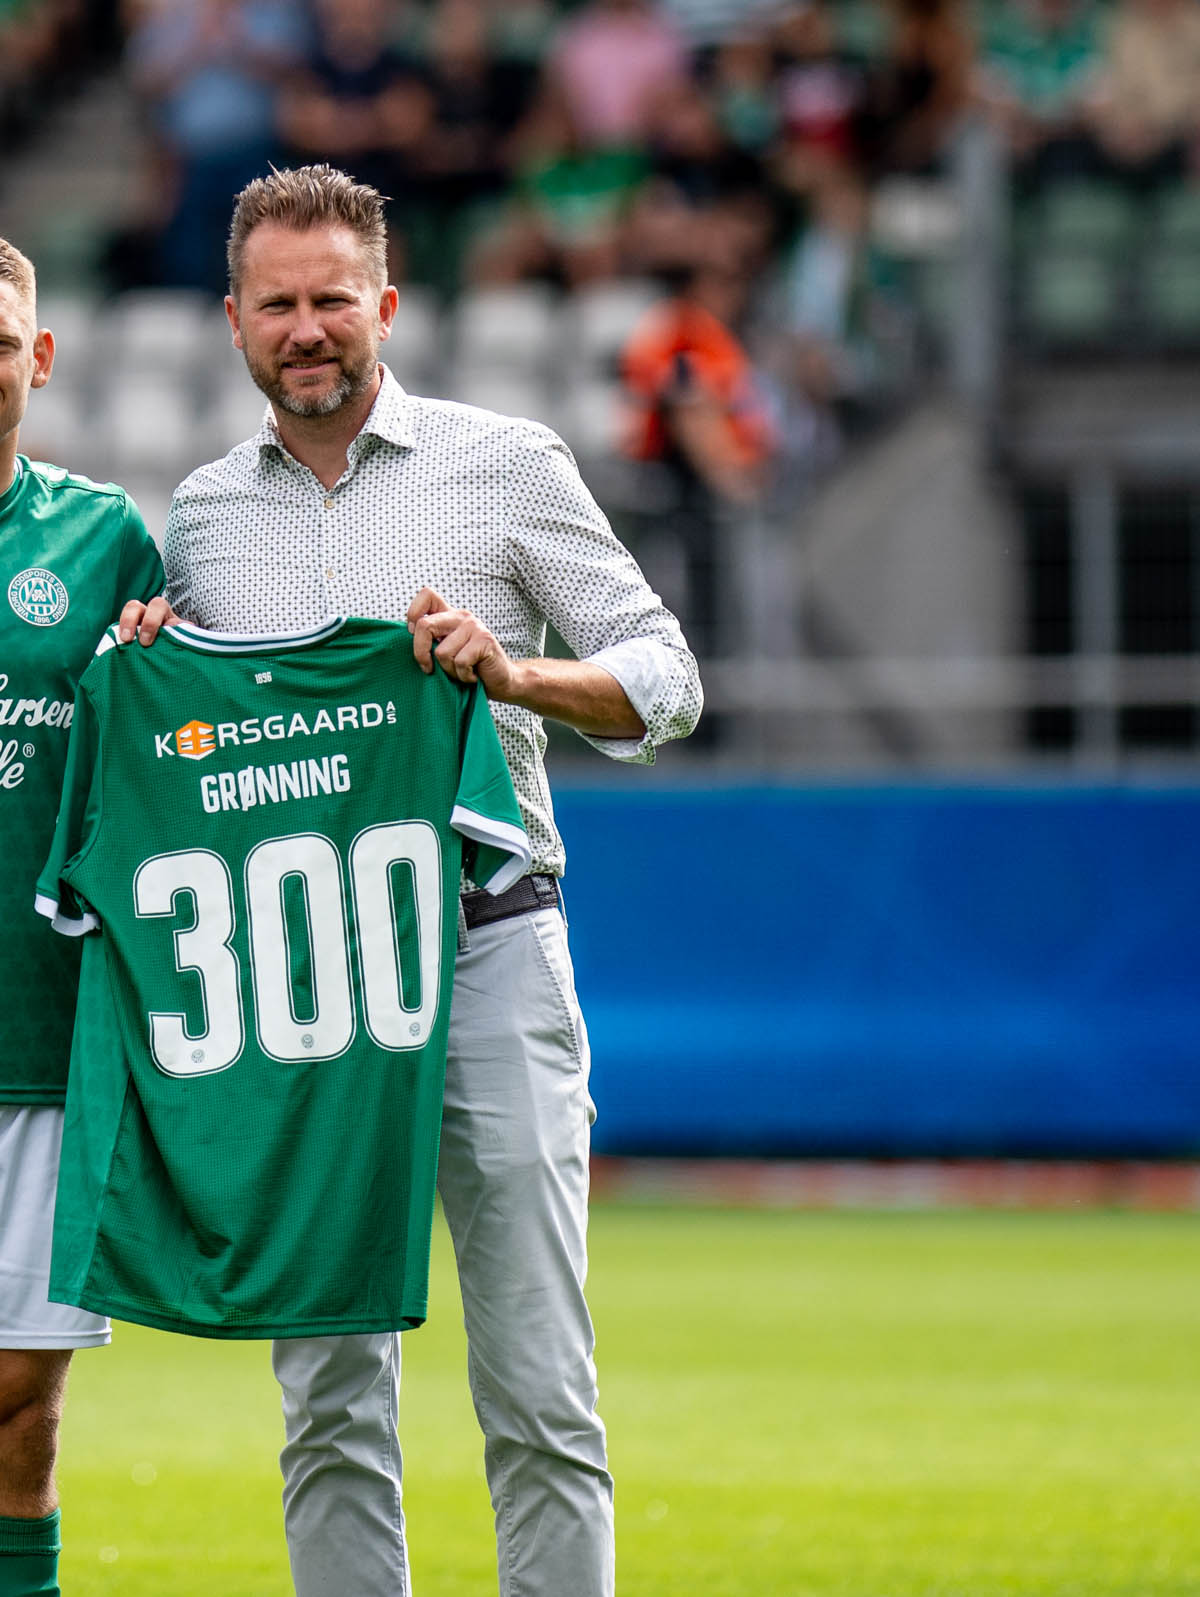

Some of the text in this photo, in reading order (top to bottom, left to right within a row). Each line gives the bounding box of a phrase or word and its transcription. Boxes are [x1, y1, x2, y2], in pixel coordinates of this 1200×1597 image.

[254, 671, 273, 685] 1896
[200, 754, 351, 813] GRØNNING
[133, 819, 443, 1078] 300
